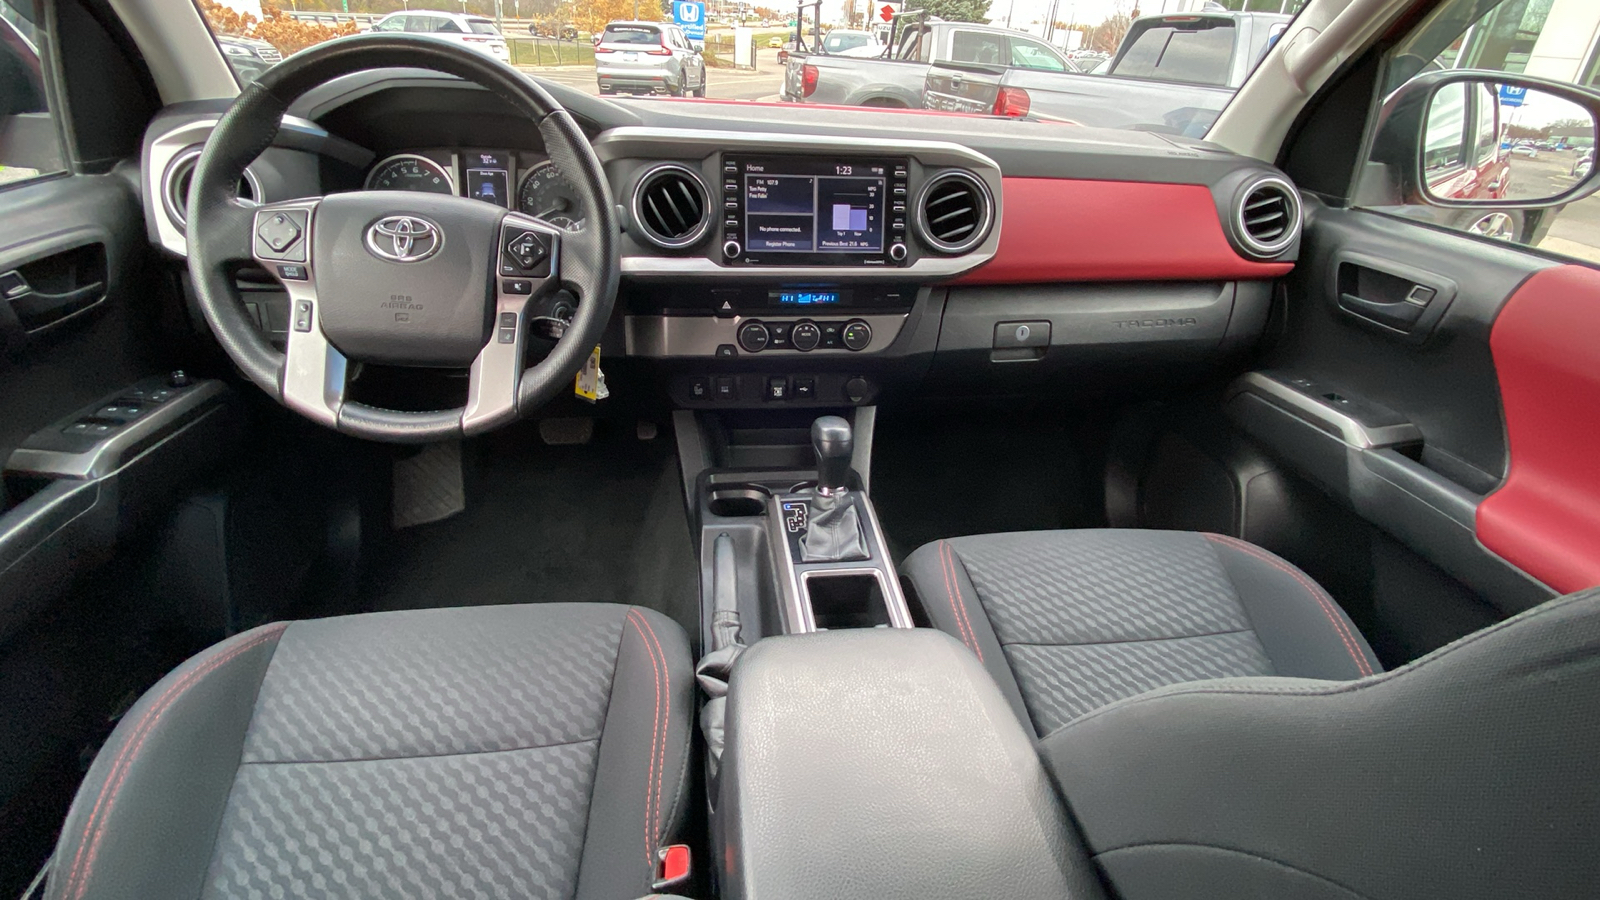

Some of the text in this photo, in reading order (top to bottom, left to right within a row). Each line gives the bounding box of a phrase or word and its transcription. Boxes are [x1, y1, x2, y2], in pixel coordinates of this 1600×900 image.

[746, 164, 764, 172] Home
[835, 166, 853, 175] 1:23
[432, 176, 440, 184] 8
[532, 180, 540, 190] 40
[527, 196, 534, 206] 20
[380, 302, 423, 310] AIRBAG
[1113, 317, 1197, 329] TACOMA
